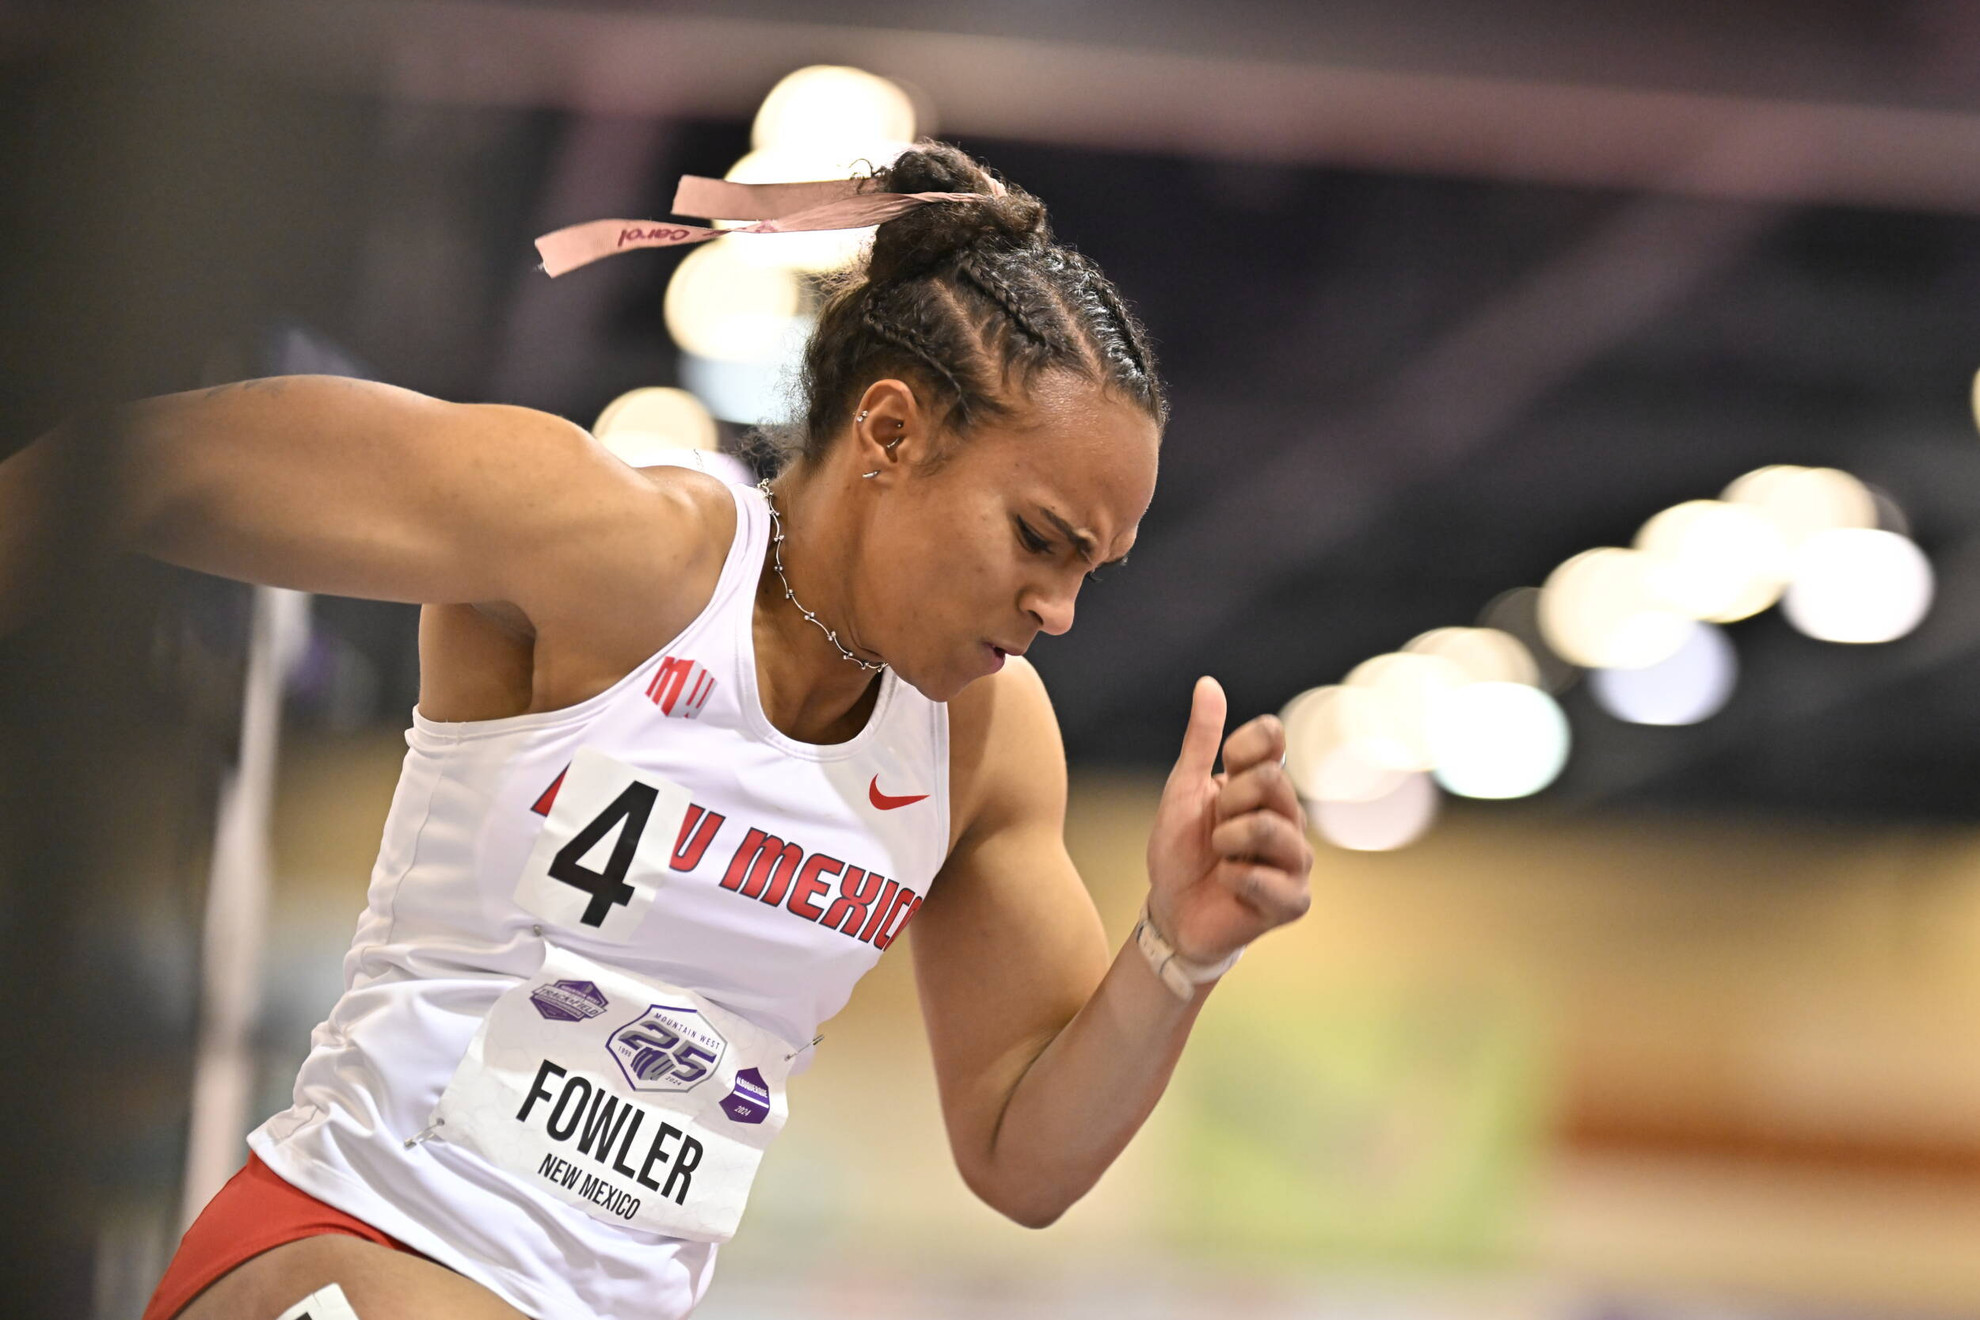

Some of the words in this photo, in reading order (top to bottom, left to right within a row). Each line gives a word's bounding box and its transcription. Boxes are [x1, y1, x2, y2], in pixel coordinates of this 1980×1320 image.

[548, 780, 660, 928] 4
[617, 1020, 718, 1082] 25
[653, 1011, 698, 1039] MOUNTAIN
[700, 1033, 721, 1050] WEST
[665, 1075, 682, 1087] 2024
[734, 1104, 752, 1117] 2024
[516, 1058, 704, 1206] FOWLER
[537, 1153, 583, 1191] NEW
[578, 1173, 641, 1220] MEXICO
